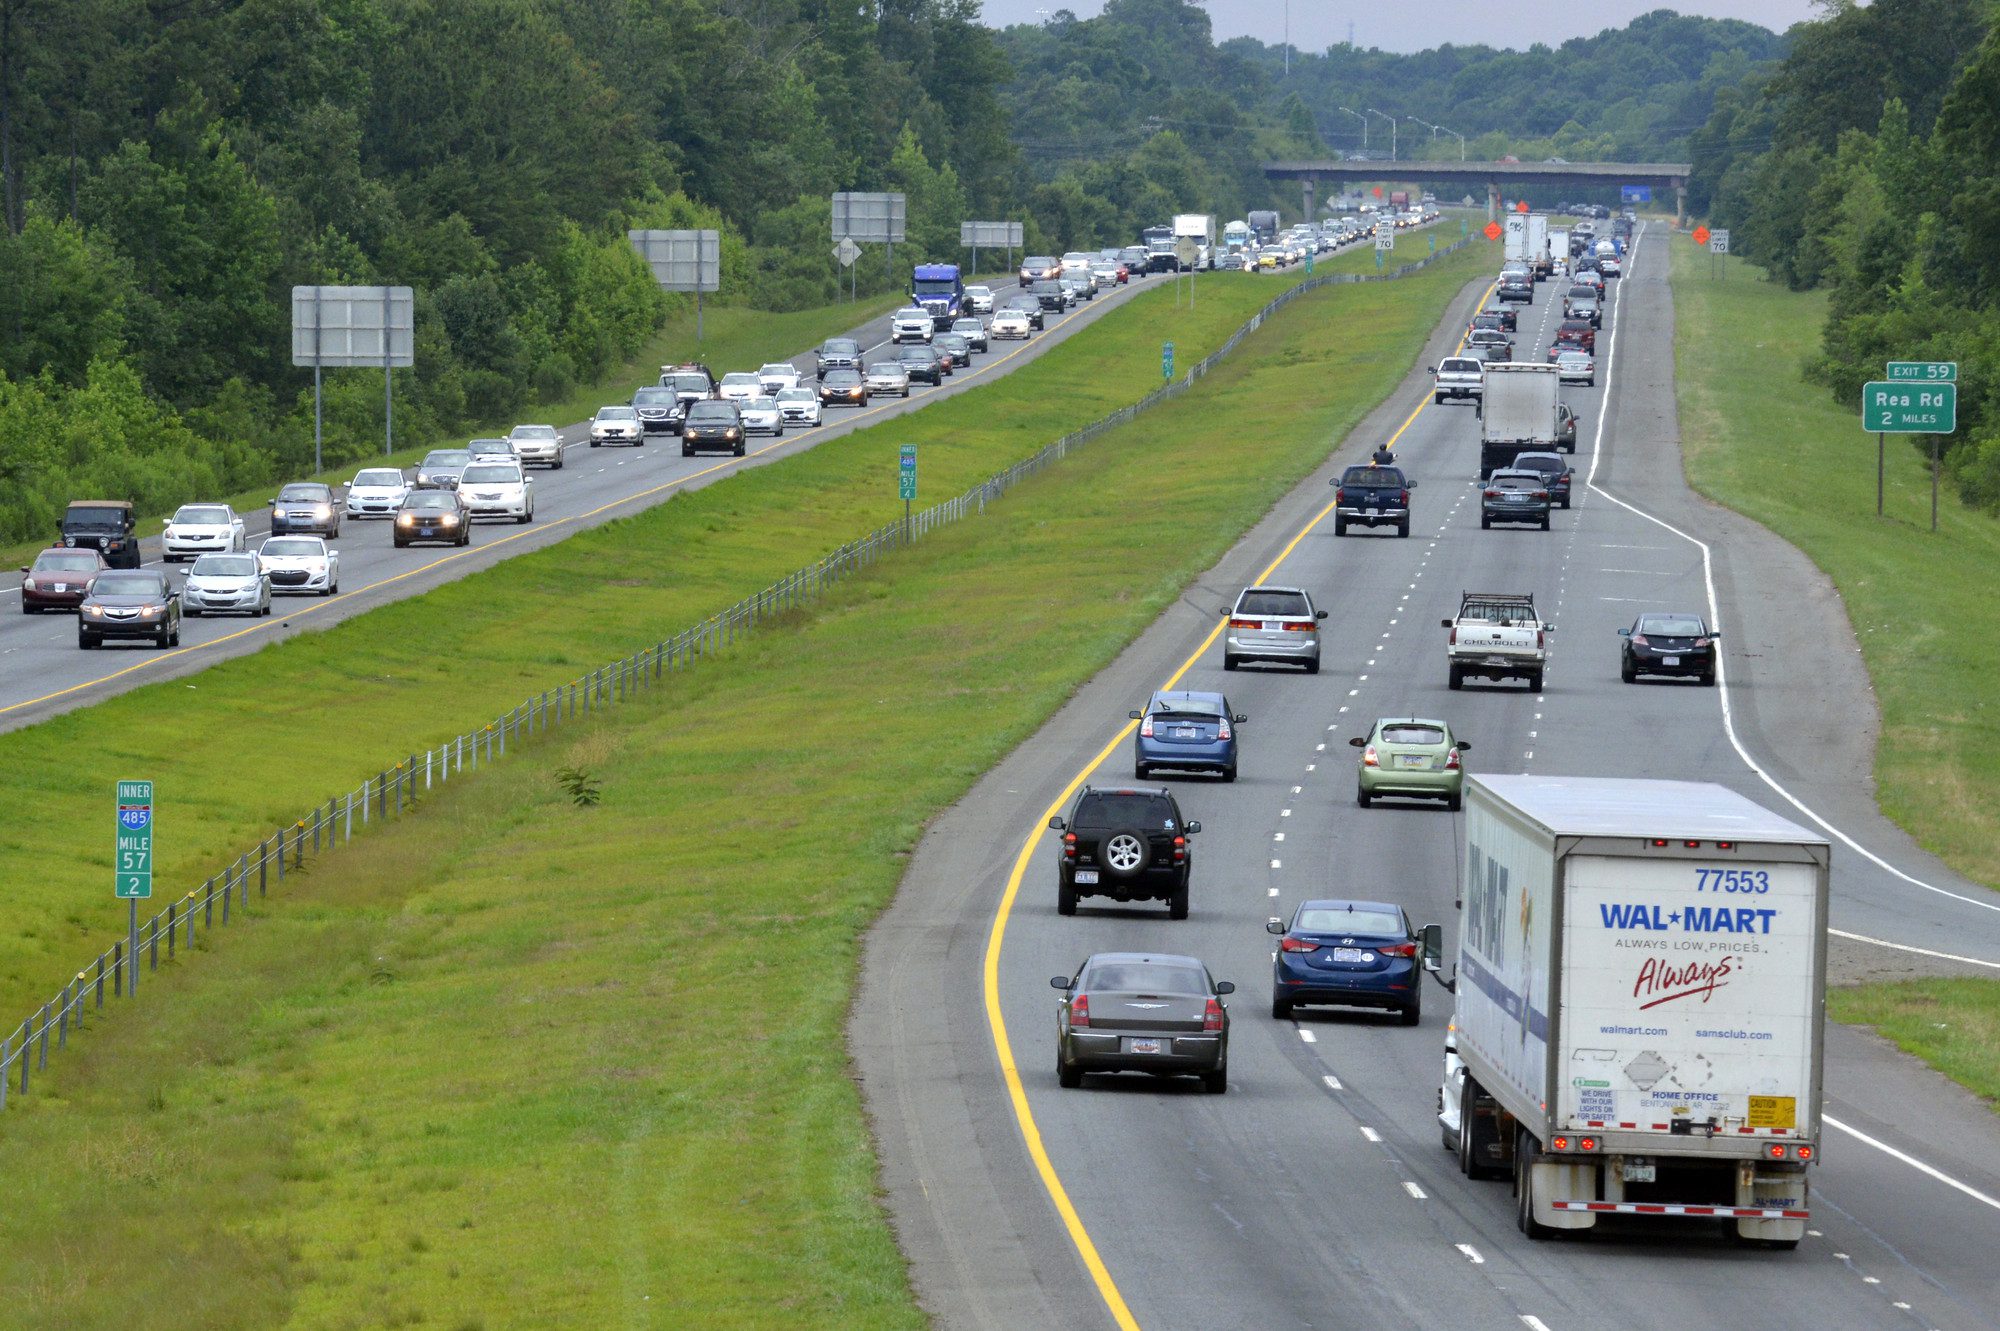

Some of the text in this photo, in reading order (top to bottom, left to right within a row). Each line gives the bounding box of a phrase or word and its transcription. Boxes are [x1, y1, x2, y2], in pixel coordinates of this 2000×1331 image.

[1379, 240, 1391, 248] 70
[1713, 242, 1726, 251] 70
[1894, 365, 1950, 379] EXIT 59
[1876, 392, 1943, 407] Rea Rd
[1881, 411, 1937, 425] 2 MILES
[903, 477, 914, 487] 57
[1464, 639, 1529, 647] CHEVROLET
[120, 784, 150, 798] INNER
[122, 811, 147, 824] 485
[119, 837, 149, 850] MILE
[123, 852, 146, 869] 57
[1695, 868, 1769, 894] 77553
[1615, 938, 1668, 949] ALWAYS
[1674, 941, 1703, 950] LOW
[1600, 1025, 1773, 1040] walmart.com samsclub.com
[1581, 1089, 1592, 1097] WE
[1652, 1091, 1719, 1101] HOME OFFICE
[1577, 1112, 1615, 1121] FOR SAFETY
